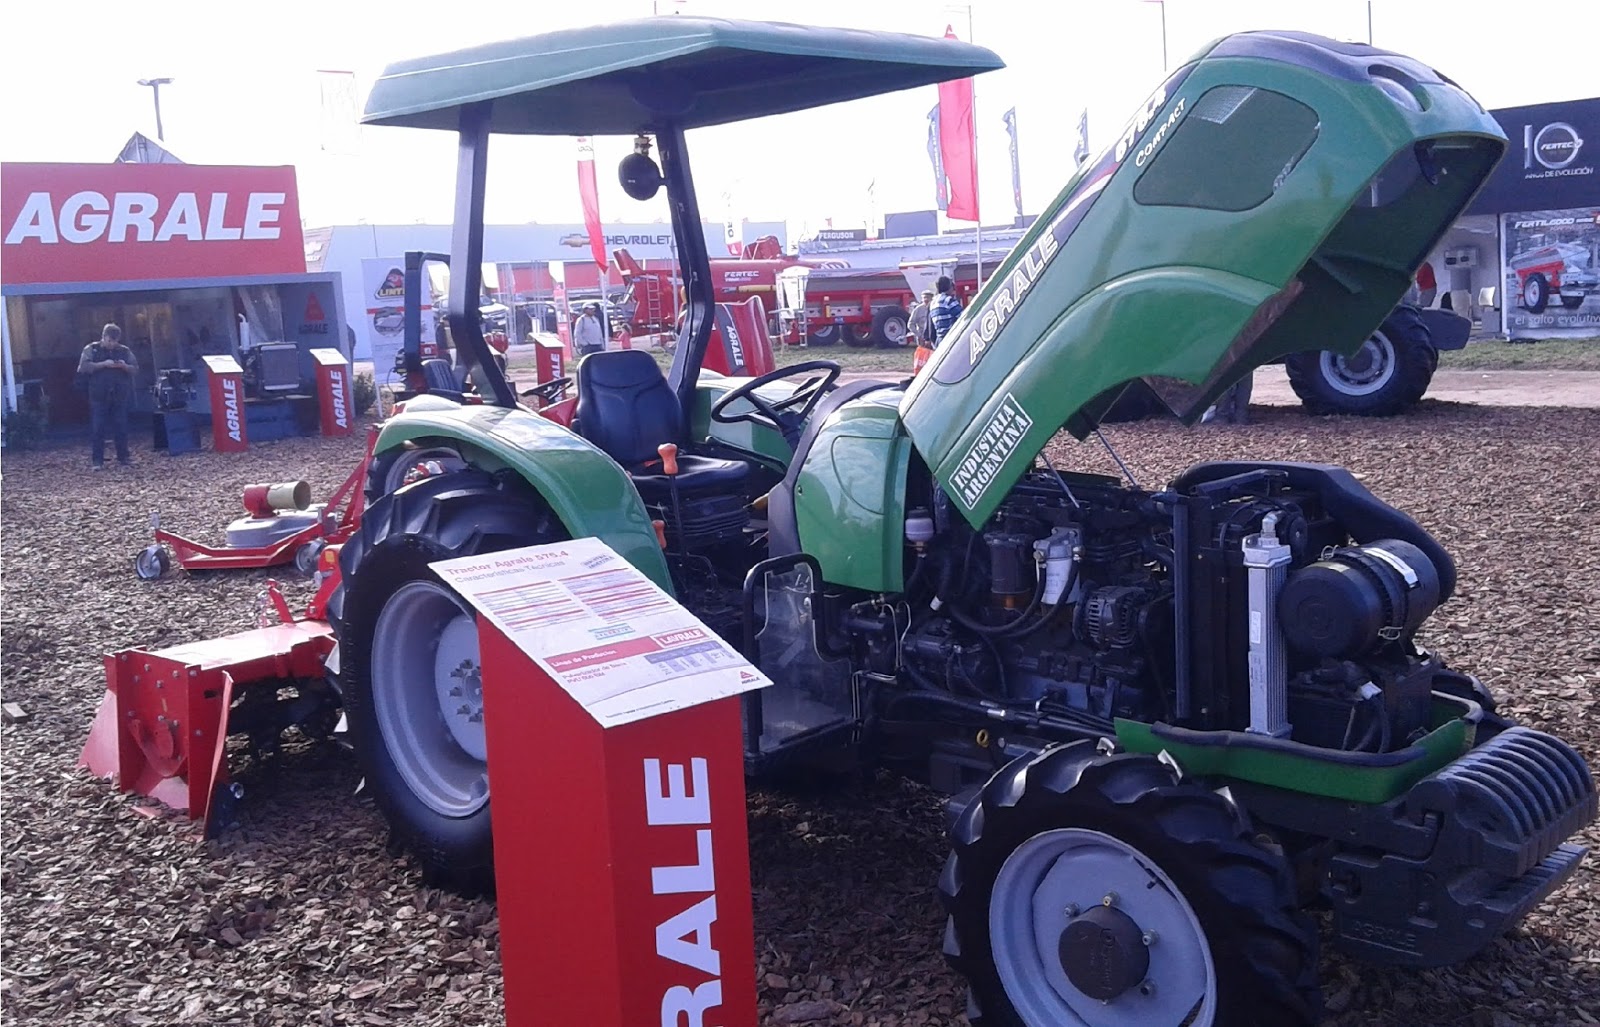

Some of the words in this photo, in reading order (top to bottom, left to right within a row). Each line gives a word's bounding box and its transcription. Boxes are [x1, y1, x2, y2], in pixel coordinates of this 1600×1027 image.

[1135, 97, 1186, 167] COMPACT
[1541, 141, 1574, 151] FERTEC
[1545, 170, 1555, 178] DE
[5, 191, 286, 244] AGRALE
[724, 270, 760, 278] FERTEC
[969, 224, 1059, 366] AGRALE
[1515, 315, 1525, 325] el
[1529, 314, 1554, 324] salto
[726, 325, 744, 366] AGRALE
[223, 378, 242, 442] AGRALE
[330, 370, 348, 429] AGRALE
[954, 404, 1016, 490] INDUSTRIA
[964, 414, 1028, 505] ARGENTINA
[444, 564, 492, 576] Tractor
[494, 556, 534, 568] Agrale
[661, 629, 705, 645] LAVRALE
